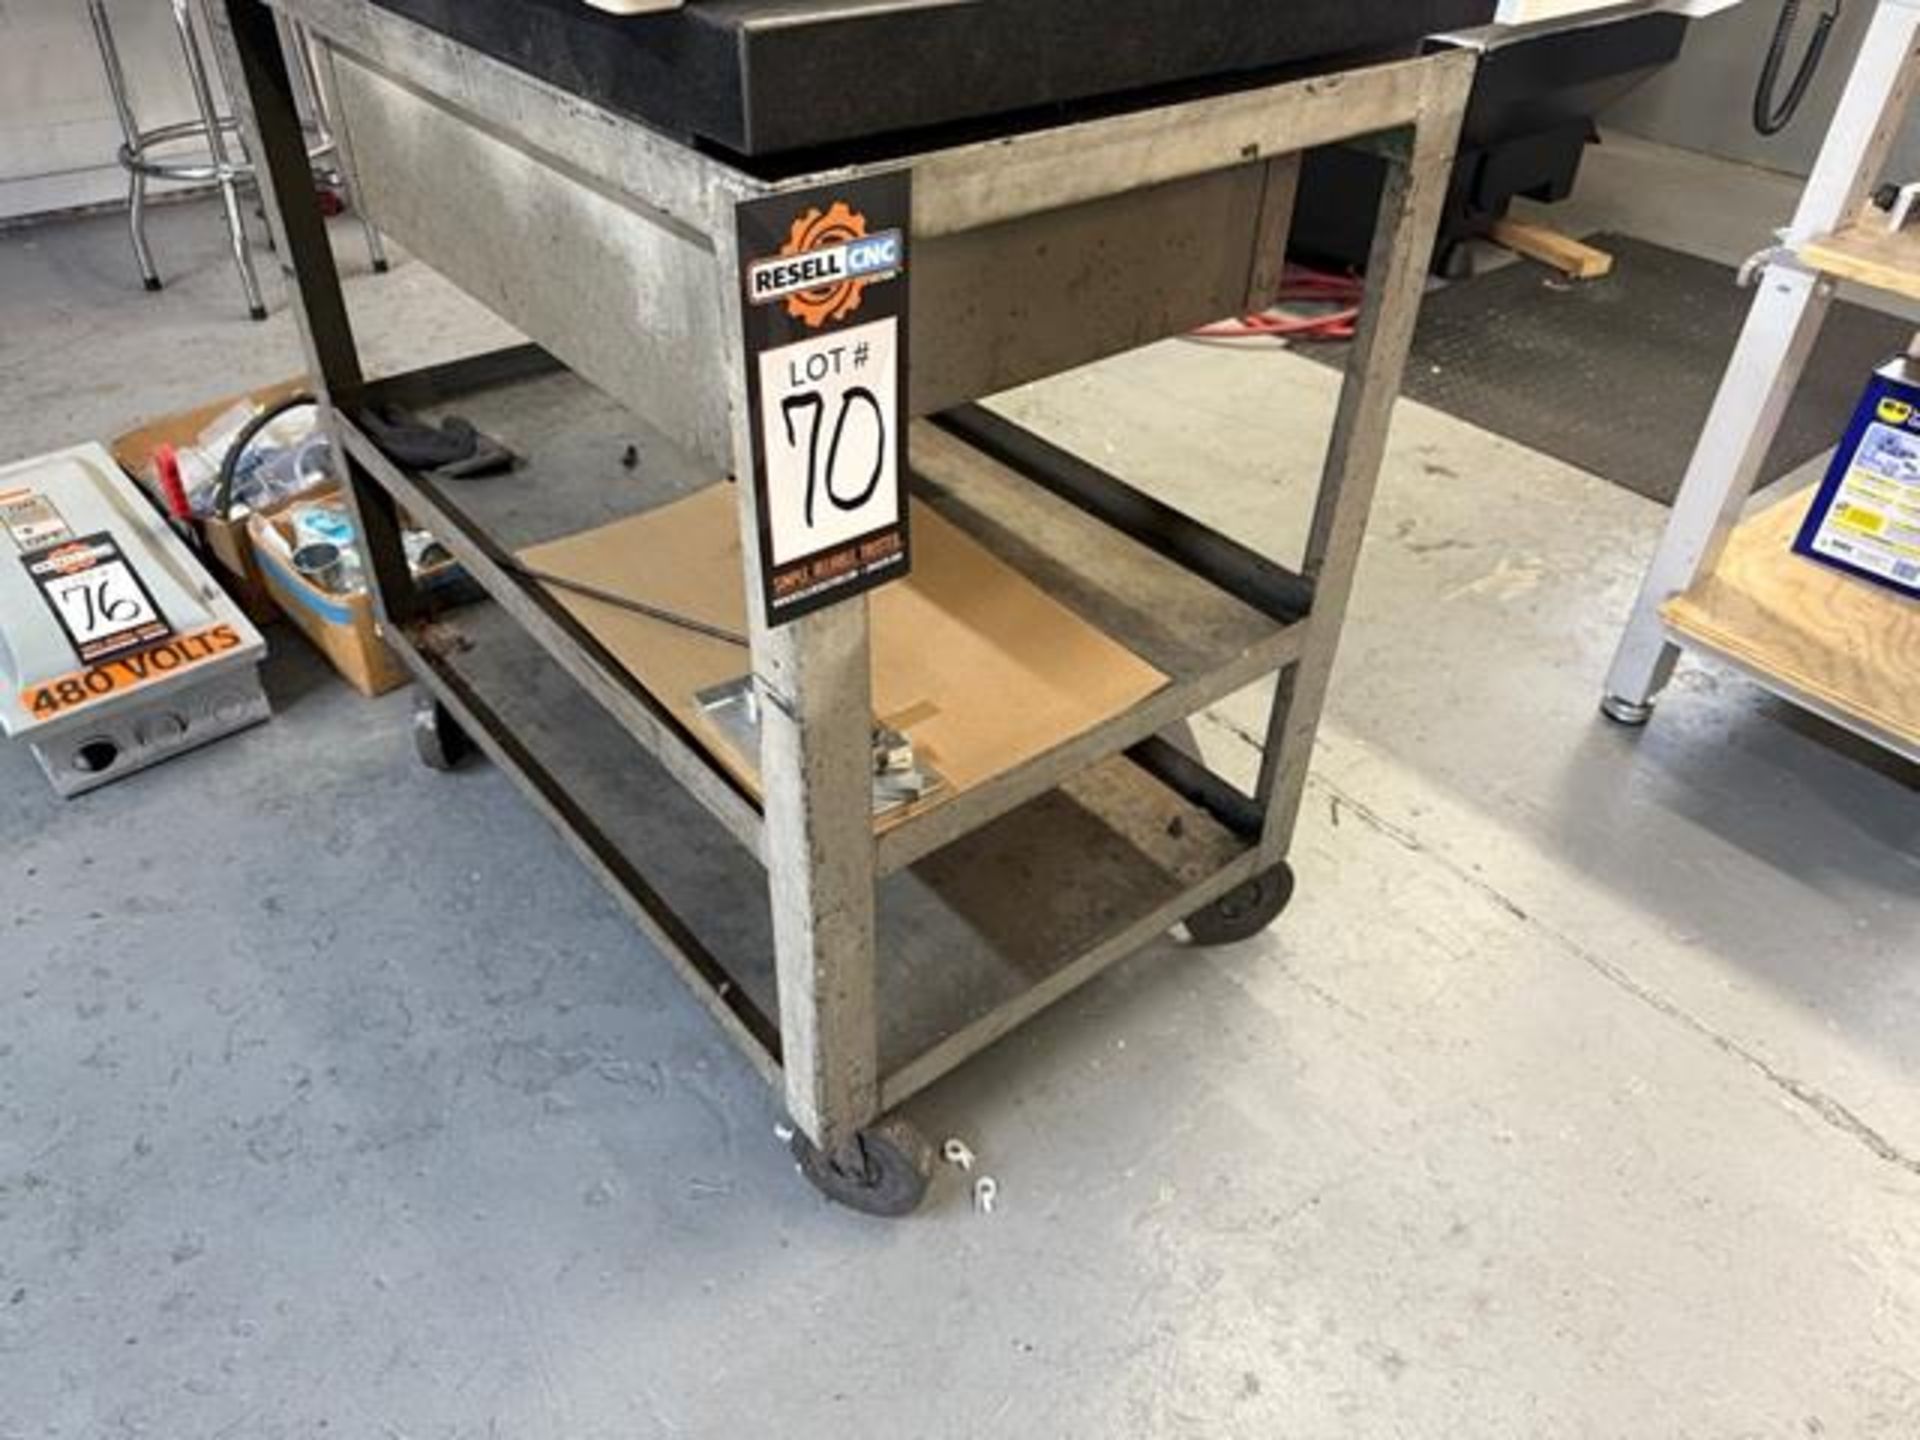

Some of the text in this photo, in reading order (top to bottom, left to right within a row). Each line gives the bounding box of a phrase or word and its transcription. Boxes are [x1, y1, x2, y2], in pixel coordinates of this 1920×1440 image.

[755, 239, 896, 294] RESELL CNC
[789, 341, 869, 387] LOT #
[781, 387, 885, 528] 70
[61, 580, 142, 632] 76
[32, 667, 115, 714] 480
[117, 625, 241, 680] VOLTS
